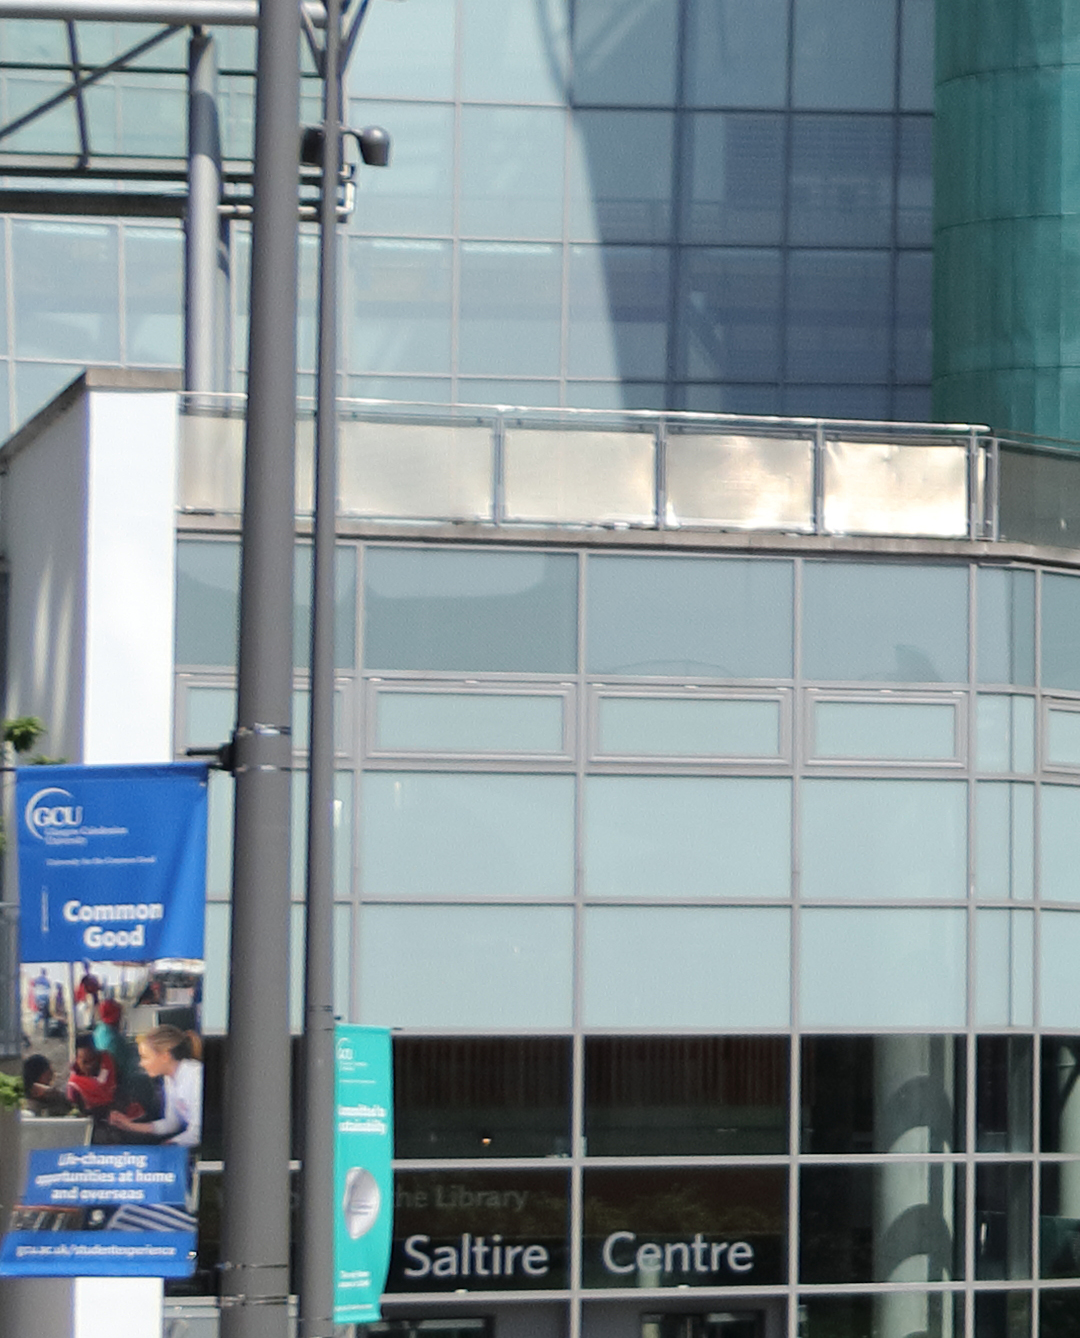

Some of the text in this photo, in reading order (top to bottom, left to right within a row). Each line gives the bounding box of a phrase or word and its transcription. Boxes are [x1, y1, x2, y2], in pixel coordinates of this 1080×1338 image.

[33, 806, 83, 827] GCU
[63, 899, 164, 923] Common
[83, 924, 146, 949] Good
[118, 1170, 133, 1182] at
[135, 1170, 176, 1182] home
[51, 1186, 146, 1200] and overseas
[437, 1184, 529, 1214] Library
[404, 1231, 755, 1277] Saltire Centre
